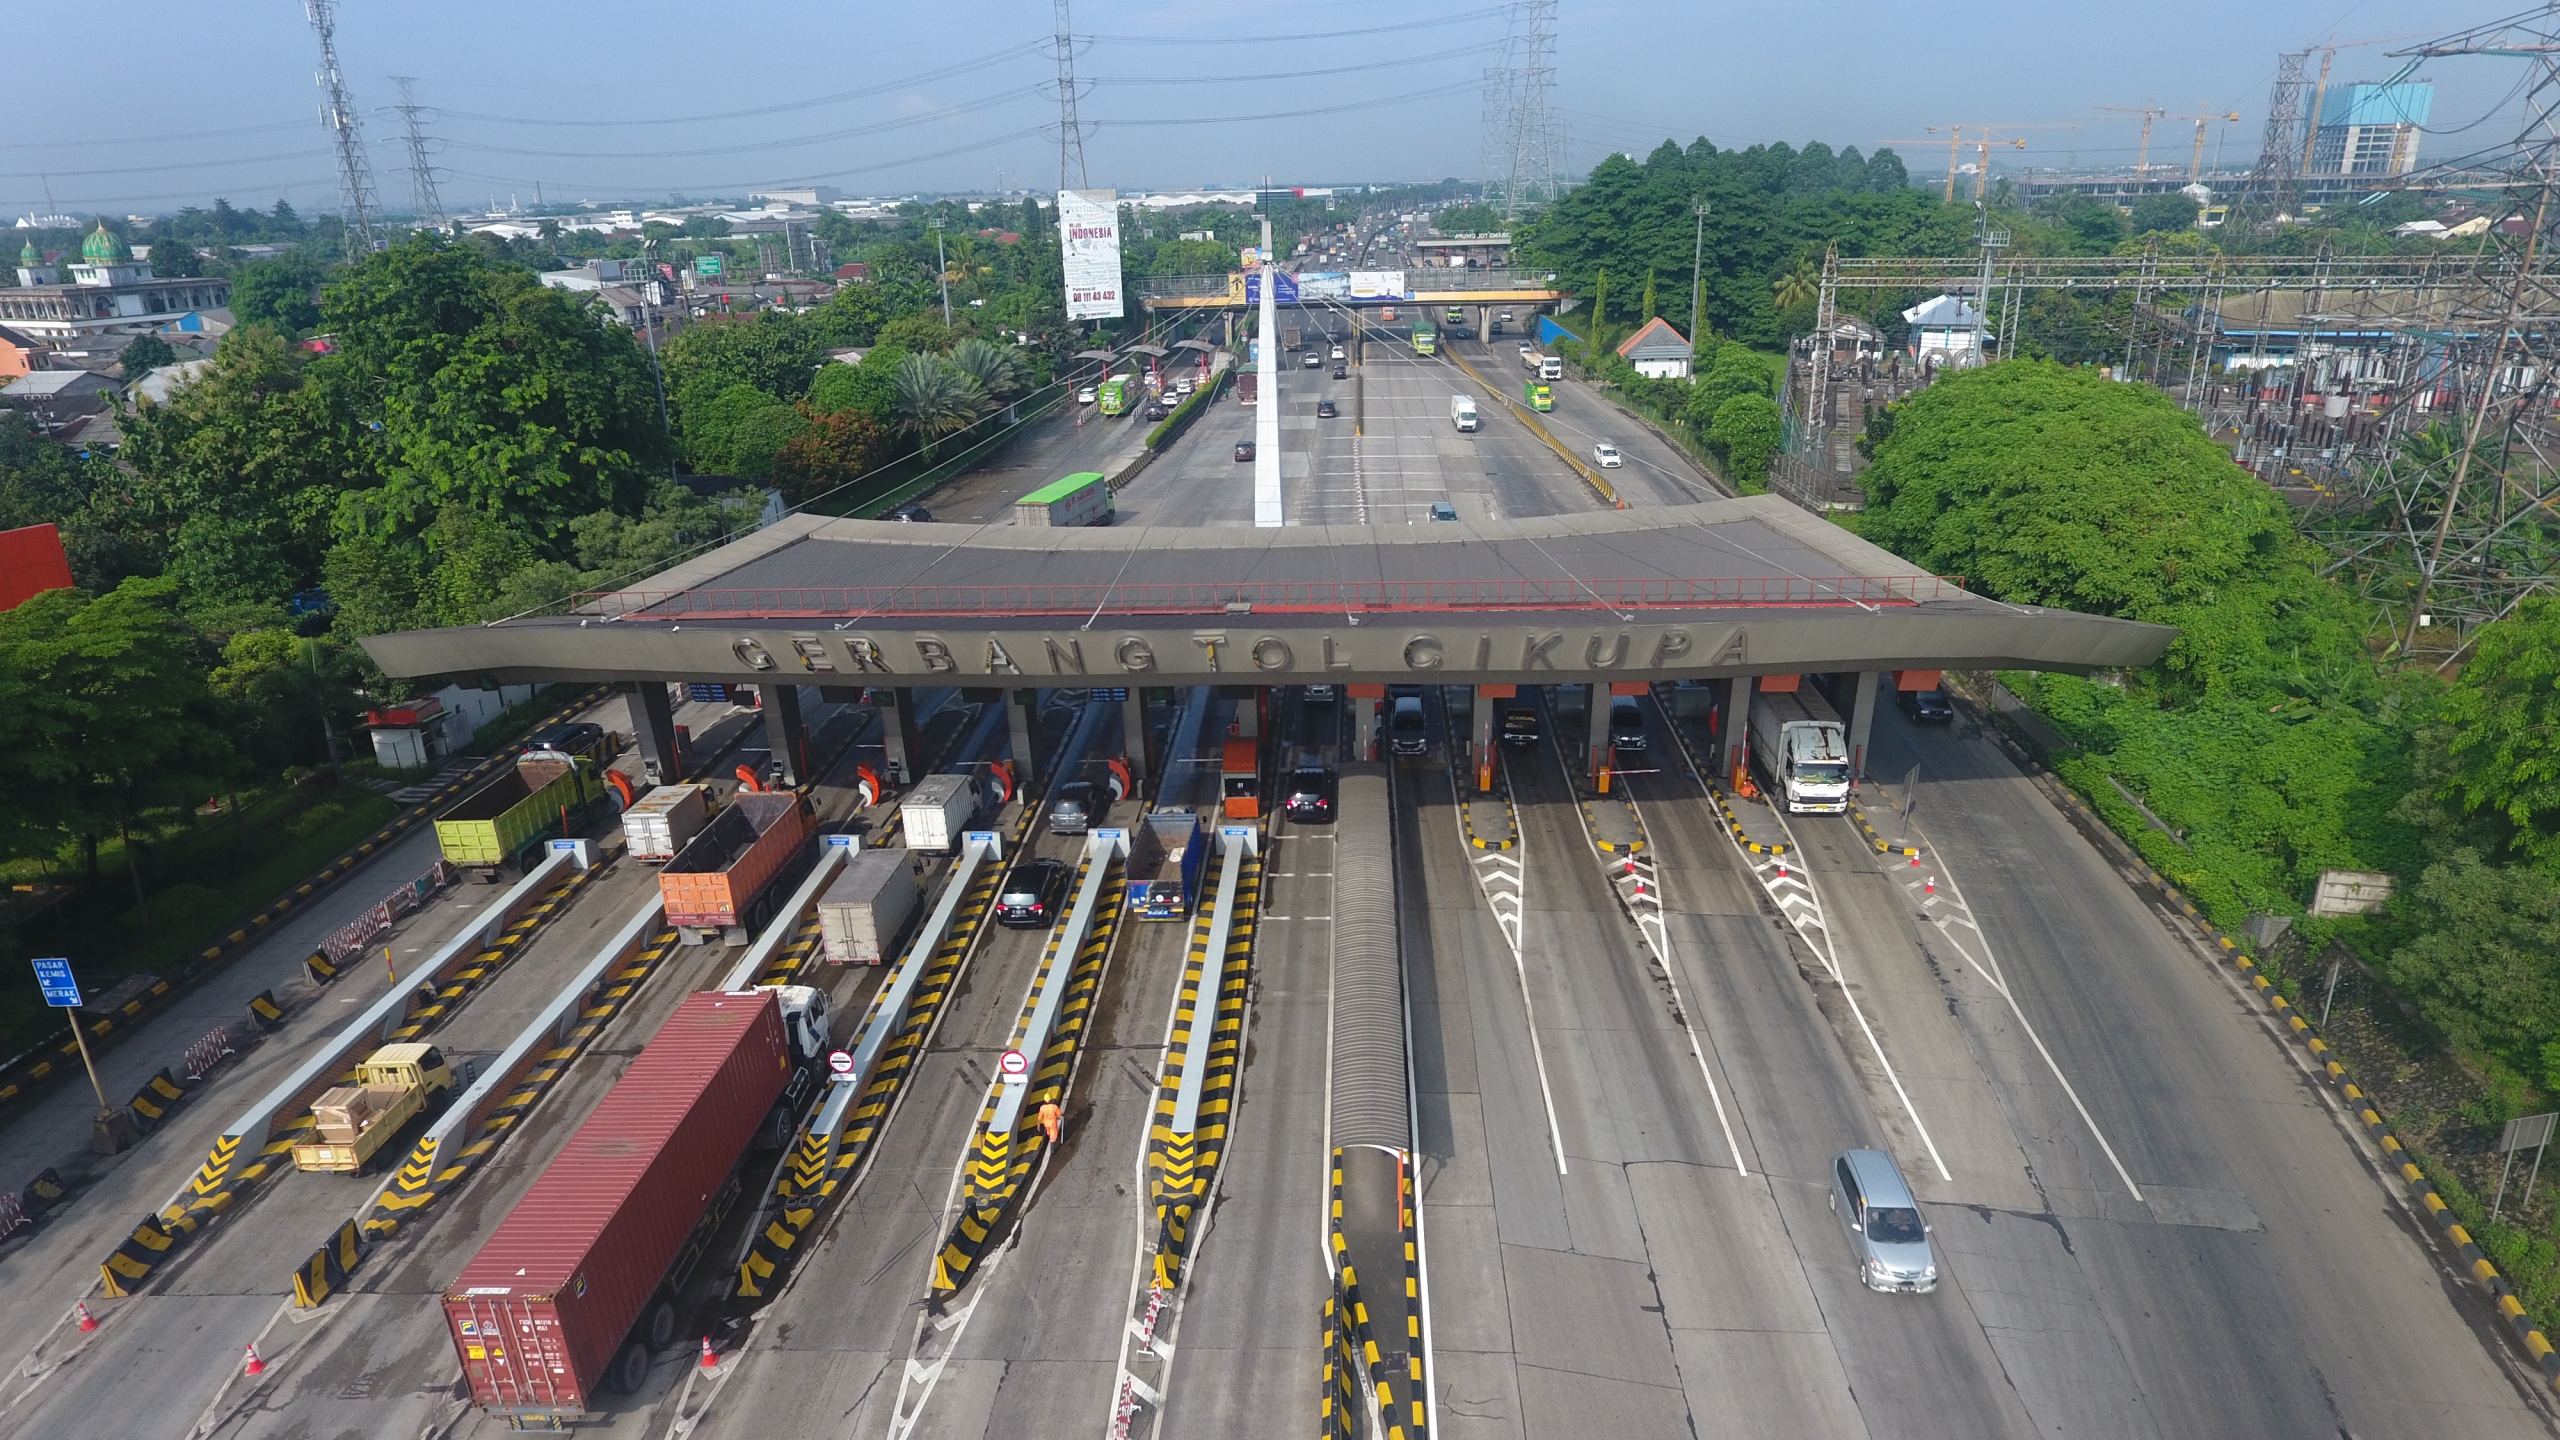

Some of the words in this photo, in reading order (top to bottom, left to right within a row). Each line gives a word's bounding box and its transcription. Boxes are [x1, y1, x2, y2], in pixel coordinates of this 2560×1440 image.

[1069, 227, 1112, 240] INDONESIA
[732, 634, 1156, 675] GERBANG
[1192, 633, 1352, 673] TOL
[1402, 626, 1749, 672] CIKUPA
[36, 961, 64, 969] PASAR
[39, 970, 66, 978] KEMIS
[45, 990, 75, 998] MERAK
